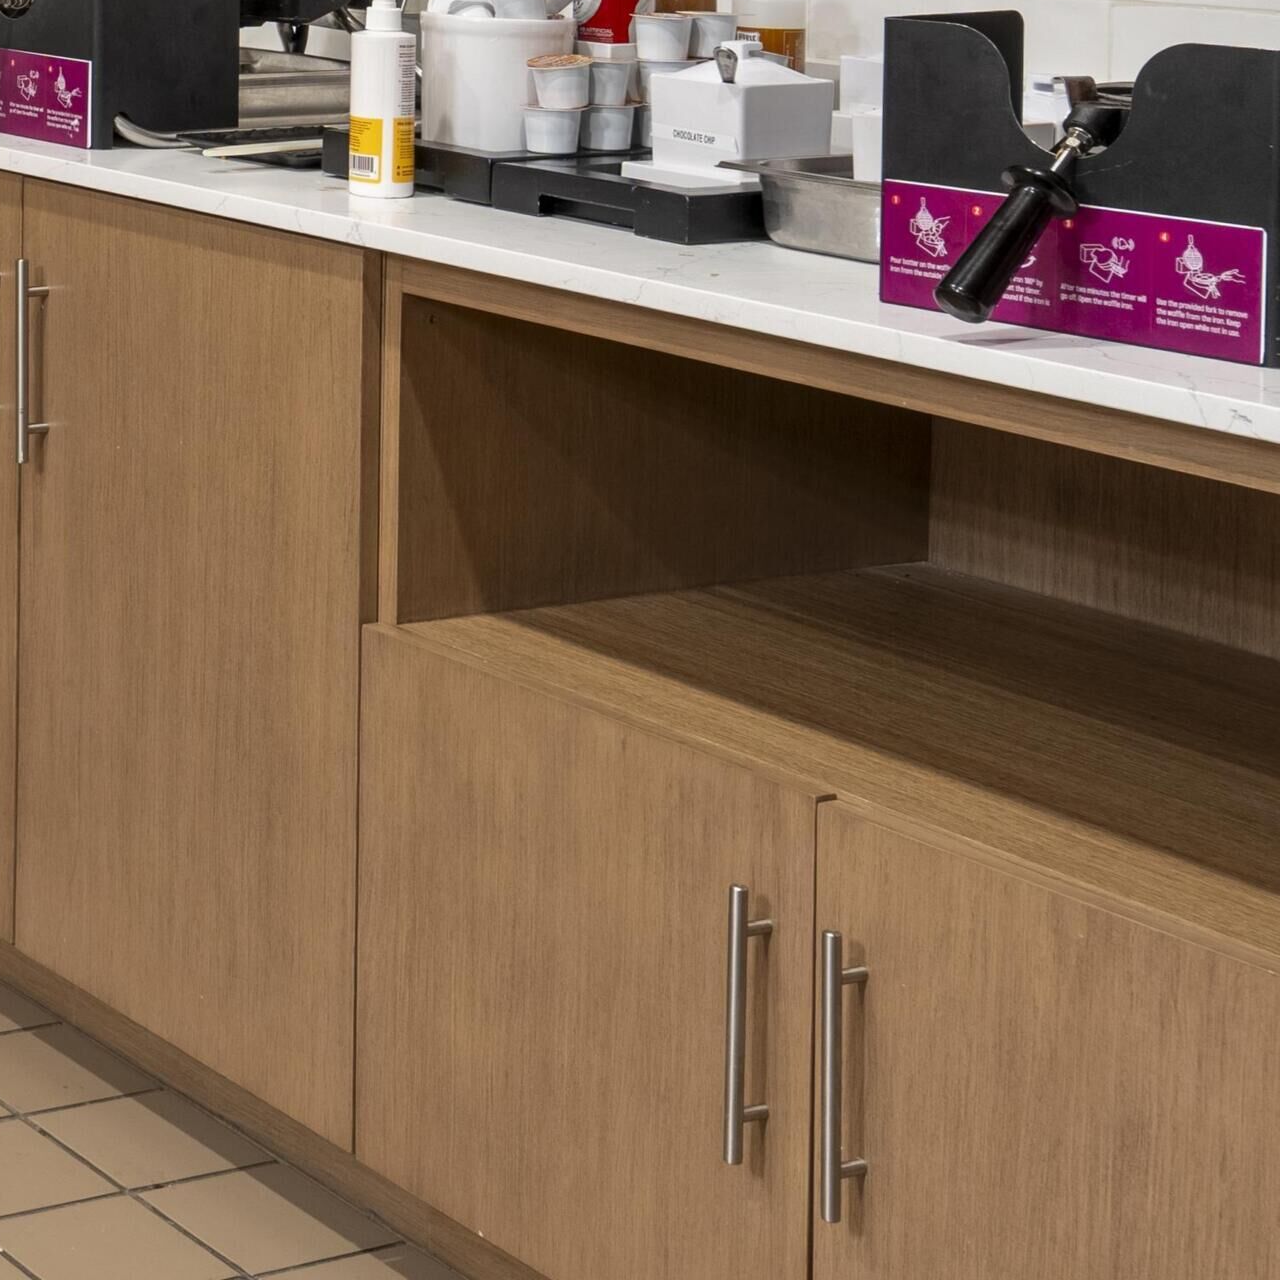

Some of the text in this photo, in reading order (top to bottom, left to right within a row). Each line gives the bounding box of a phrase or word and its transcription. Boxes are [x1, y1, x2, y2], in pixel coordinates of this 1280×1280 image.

[672, 128, 716, 145] CHOCOLATE CHIP
[1167, 299, 1178, 308] the
[1156, 307, 1167, 315] the
[1201, 314, 1211, 323] the
[1156, 317, 1166, 325] the
